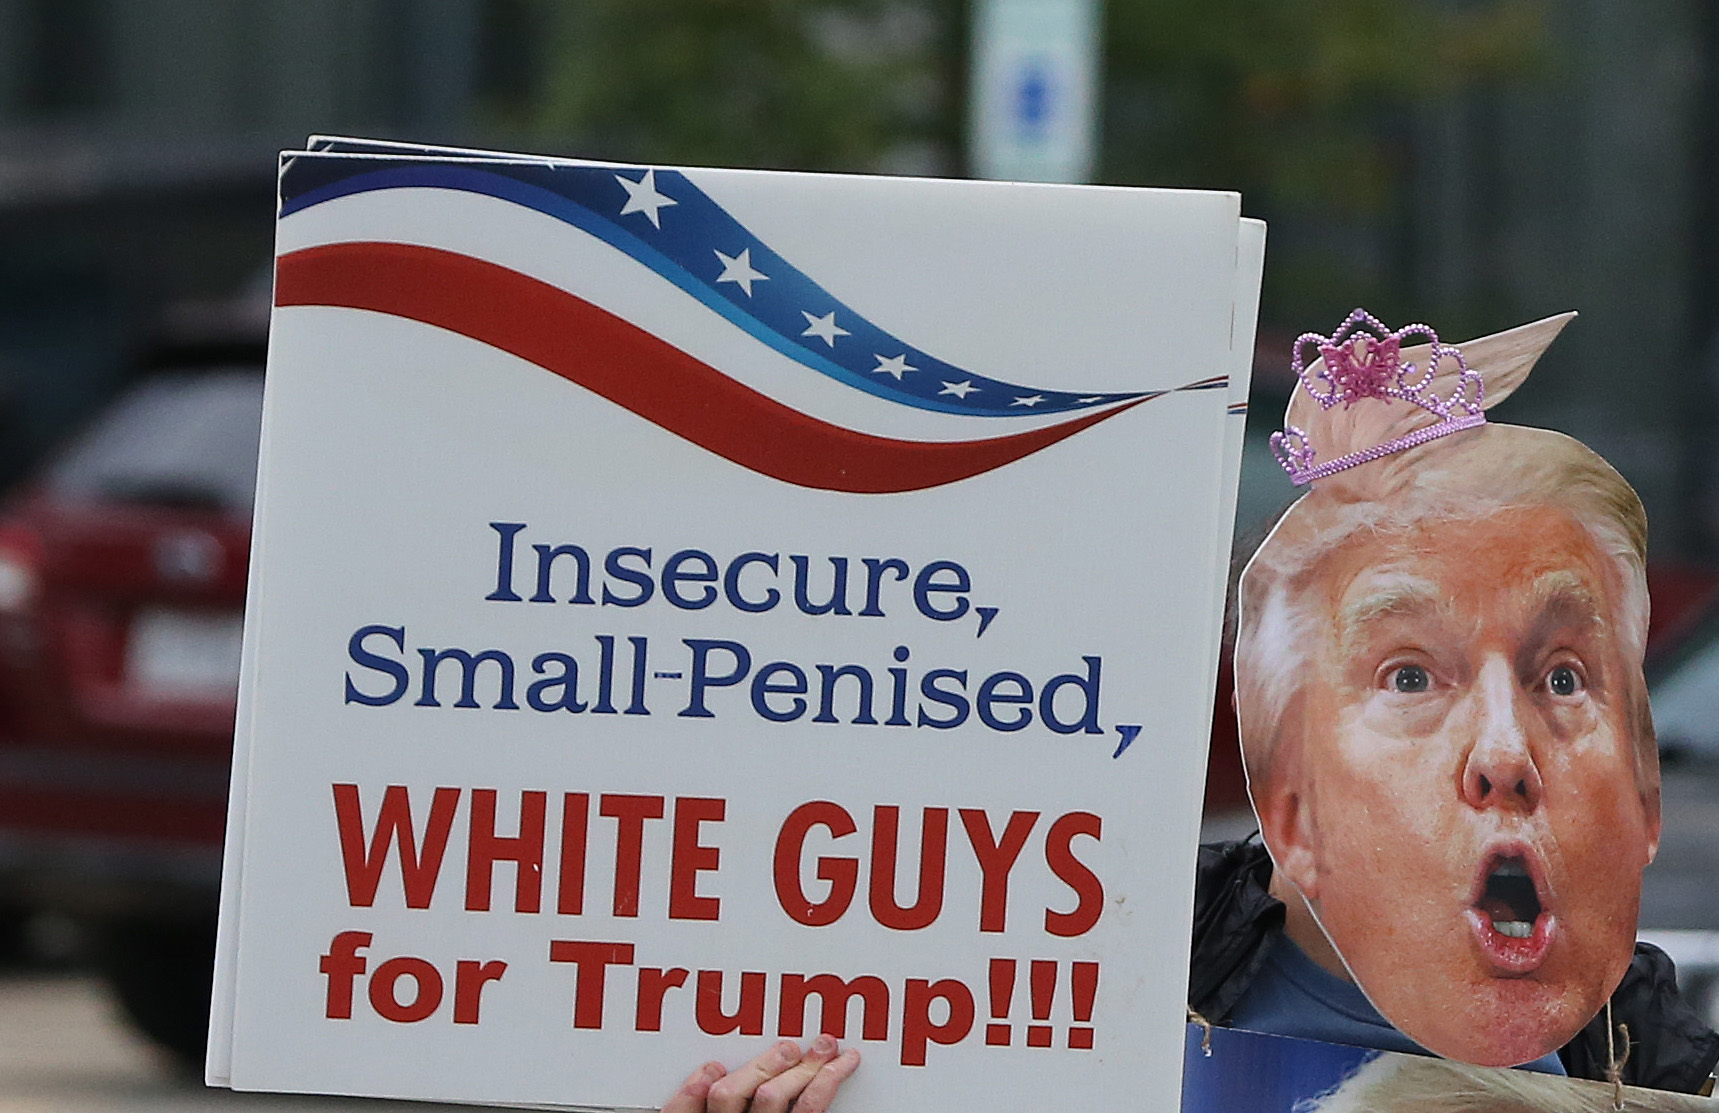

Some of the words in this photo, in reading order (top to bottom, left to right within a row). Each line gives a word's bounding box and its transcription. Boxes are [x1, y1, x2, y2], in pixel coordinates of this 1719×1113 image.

[486, 521, 1000, 637] Insecure,
[344, 624, 1144, 760] Small-Penised,
[332, 783, 727, 922] WHITE
[772, 800, 1106, 939] GUYS
[319, 930, 509, 1027] for
[549, 939, 1101, 1068] Trump!!!
